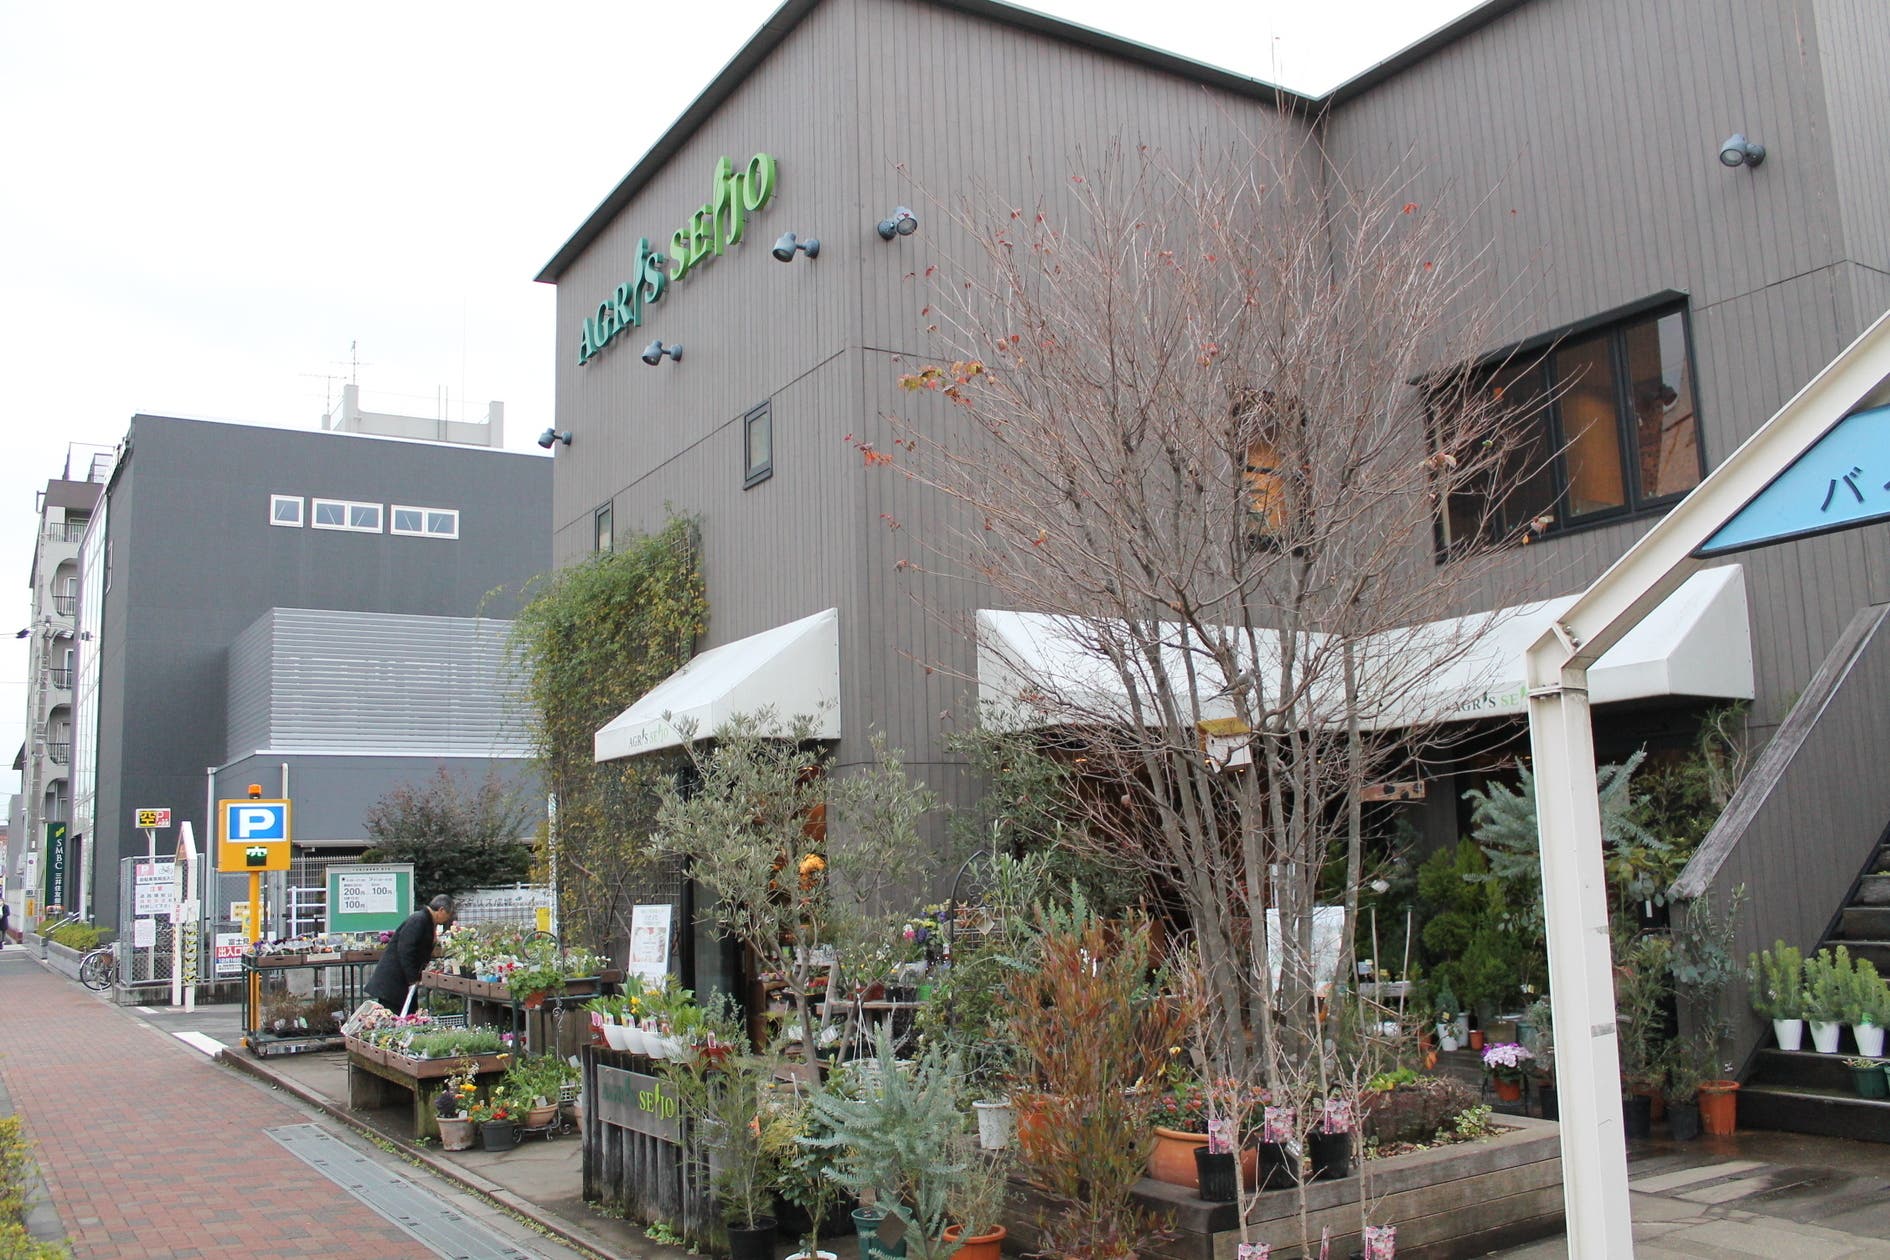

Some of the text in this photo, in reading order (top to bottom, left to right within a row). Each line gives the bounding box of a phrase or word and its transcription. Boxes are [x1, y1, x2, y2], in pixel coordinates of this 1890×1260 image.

[1820, 466, 1890, 512] バ
[239, 808, 276, 838] P
[54, 838, 64, 870] SMBC
